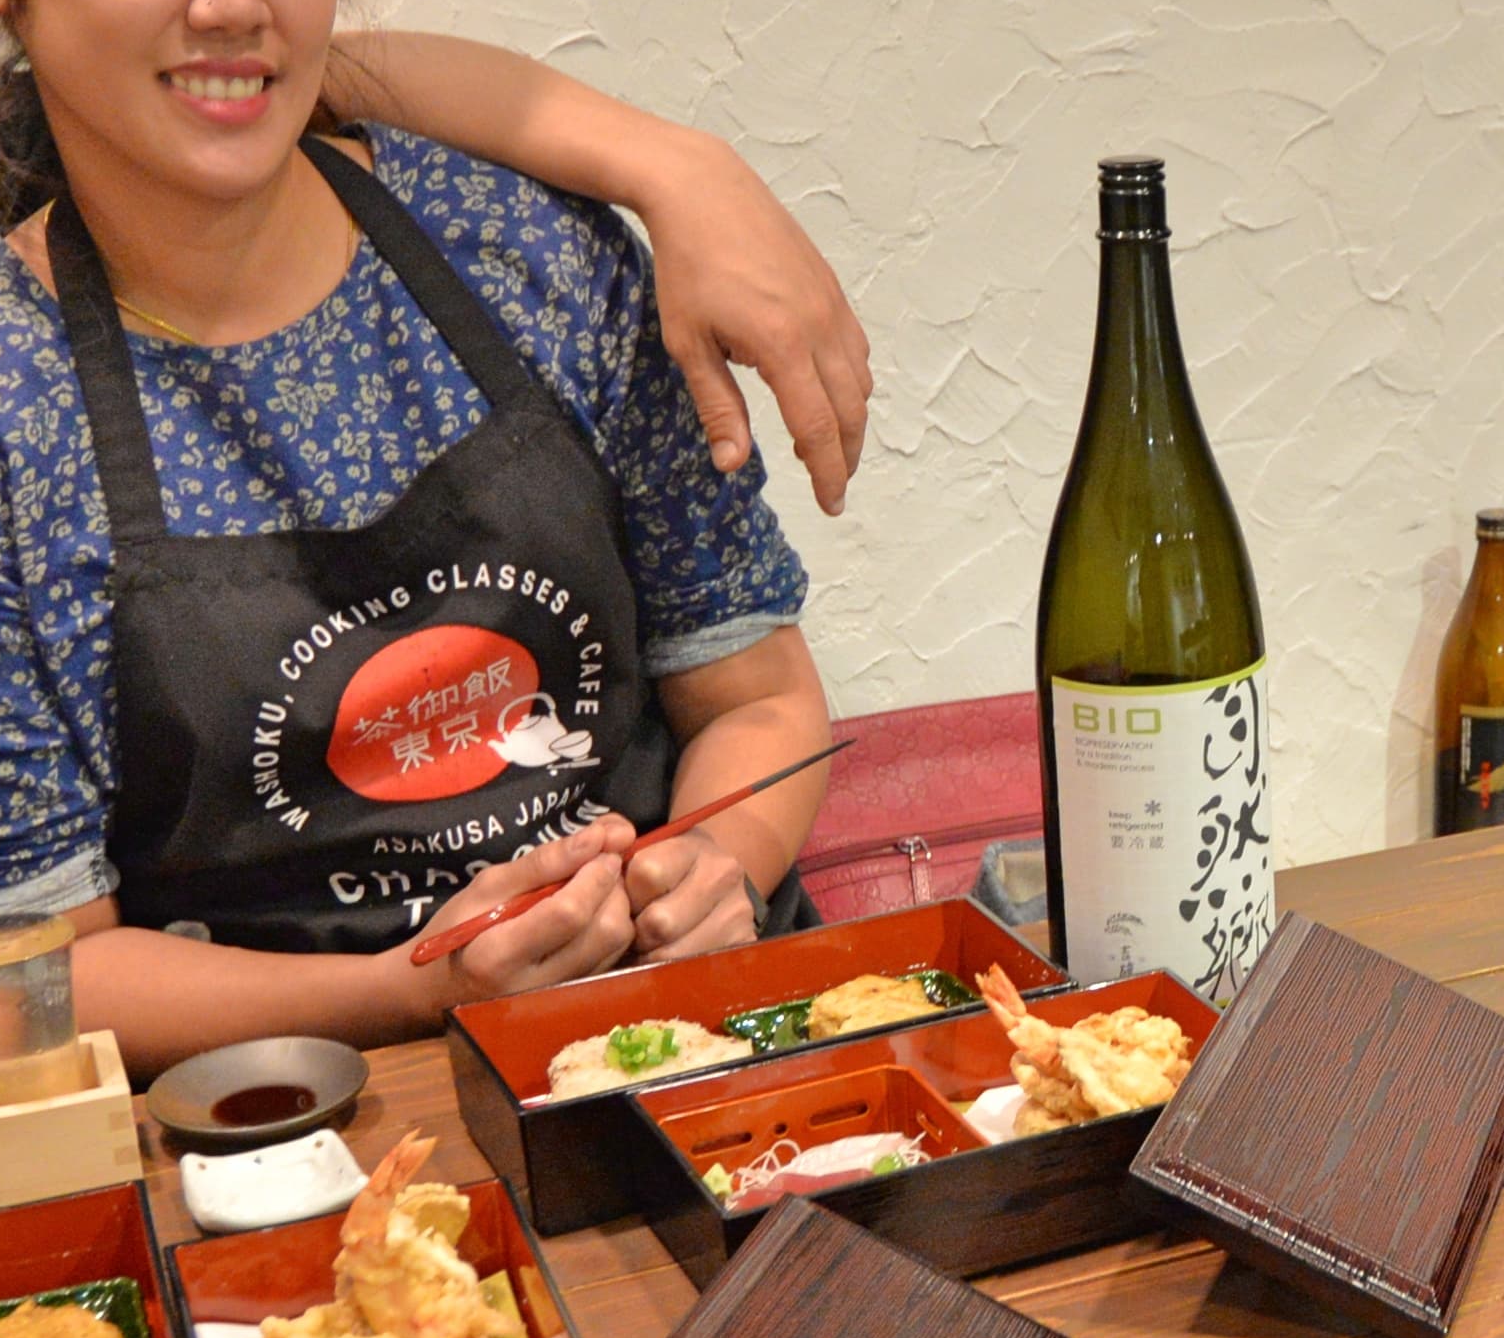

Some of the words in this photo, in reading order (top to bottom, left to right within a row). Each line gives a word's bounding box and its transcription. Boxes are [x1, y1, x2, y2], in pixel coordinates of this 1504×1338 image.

[426, 563, 570, 616] CLASSES
[280, 587, 412, 682] COOKING
[569, 613, 590, 639] &
[351, 656, 515, 747] 茶御飯
[575, 641, 603, 716] CAFE
[389, 708, 482, 774] 東京
[1072, 702, 1162, 734] BIO
[253, 693, 311, 833] WASHOKU,
[373, 814, 505, 854] ASAKUSA
[1108, 810, 1132, 822] keep
[1108, 821, 1164, 831] refrigerated
